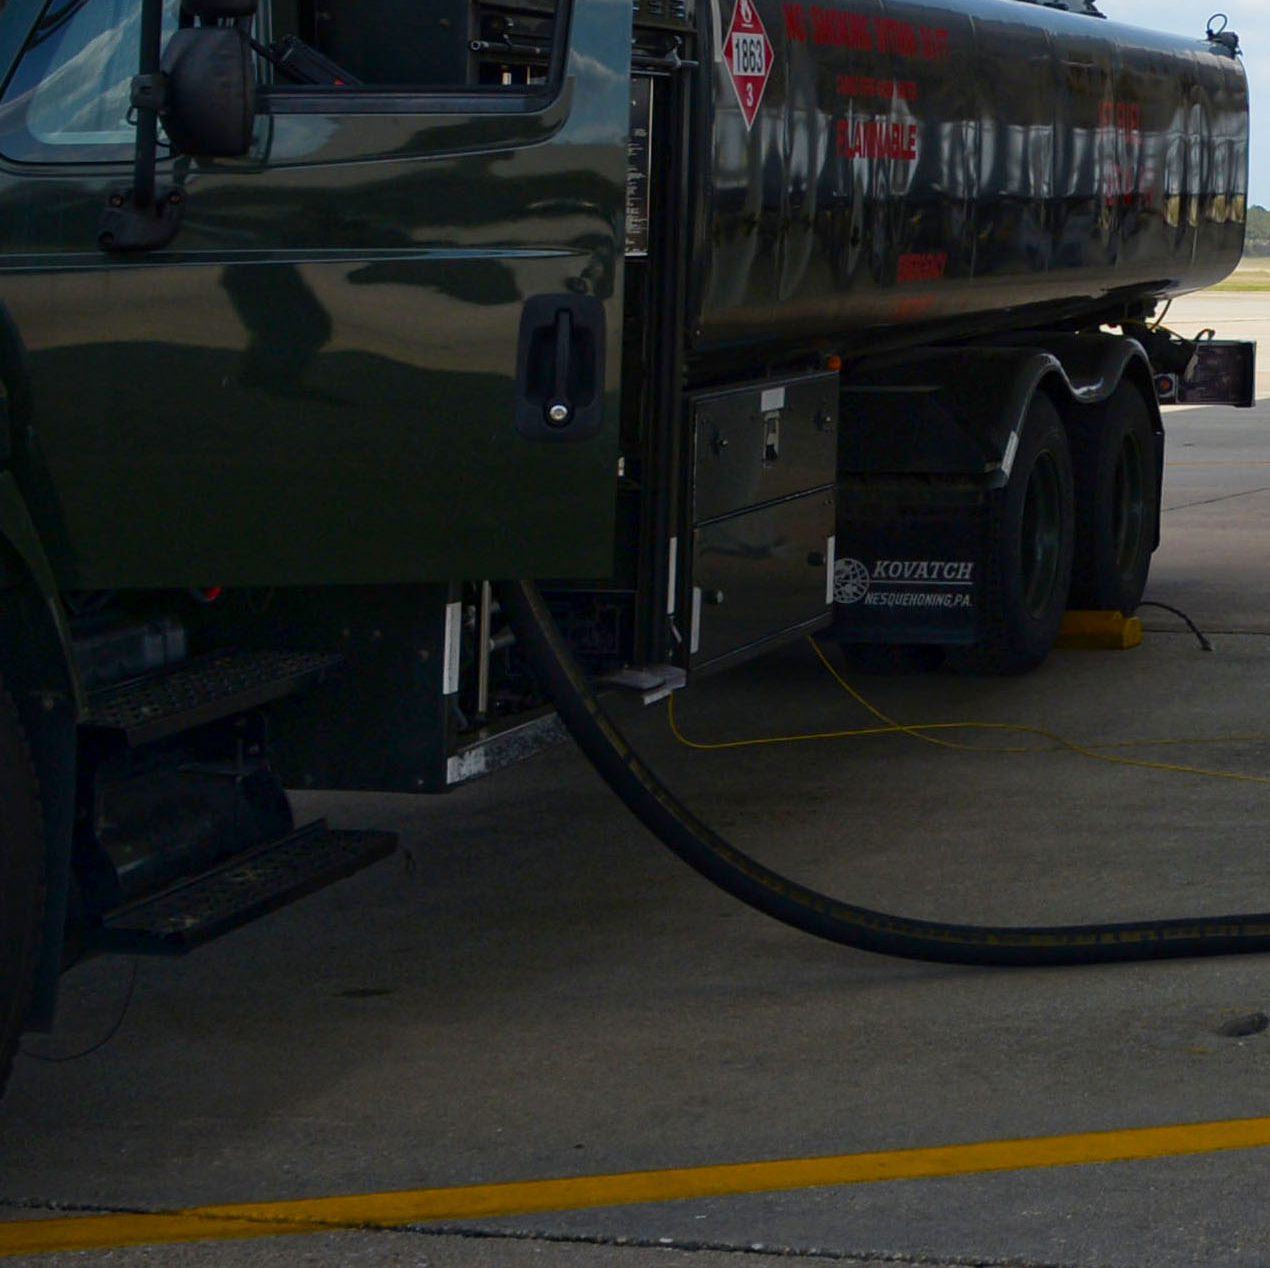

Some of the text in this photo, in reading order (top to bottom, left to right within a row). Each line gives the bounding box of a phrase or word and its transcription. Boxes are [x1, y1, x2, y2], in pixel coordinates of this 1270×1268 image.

[734, 38, 763, 73] 1863
[746, 83, 754, 107] 3
[836, 118, 916, 160] FLAMMABLE
[872, 560, 974, 579] KOVATCH
